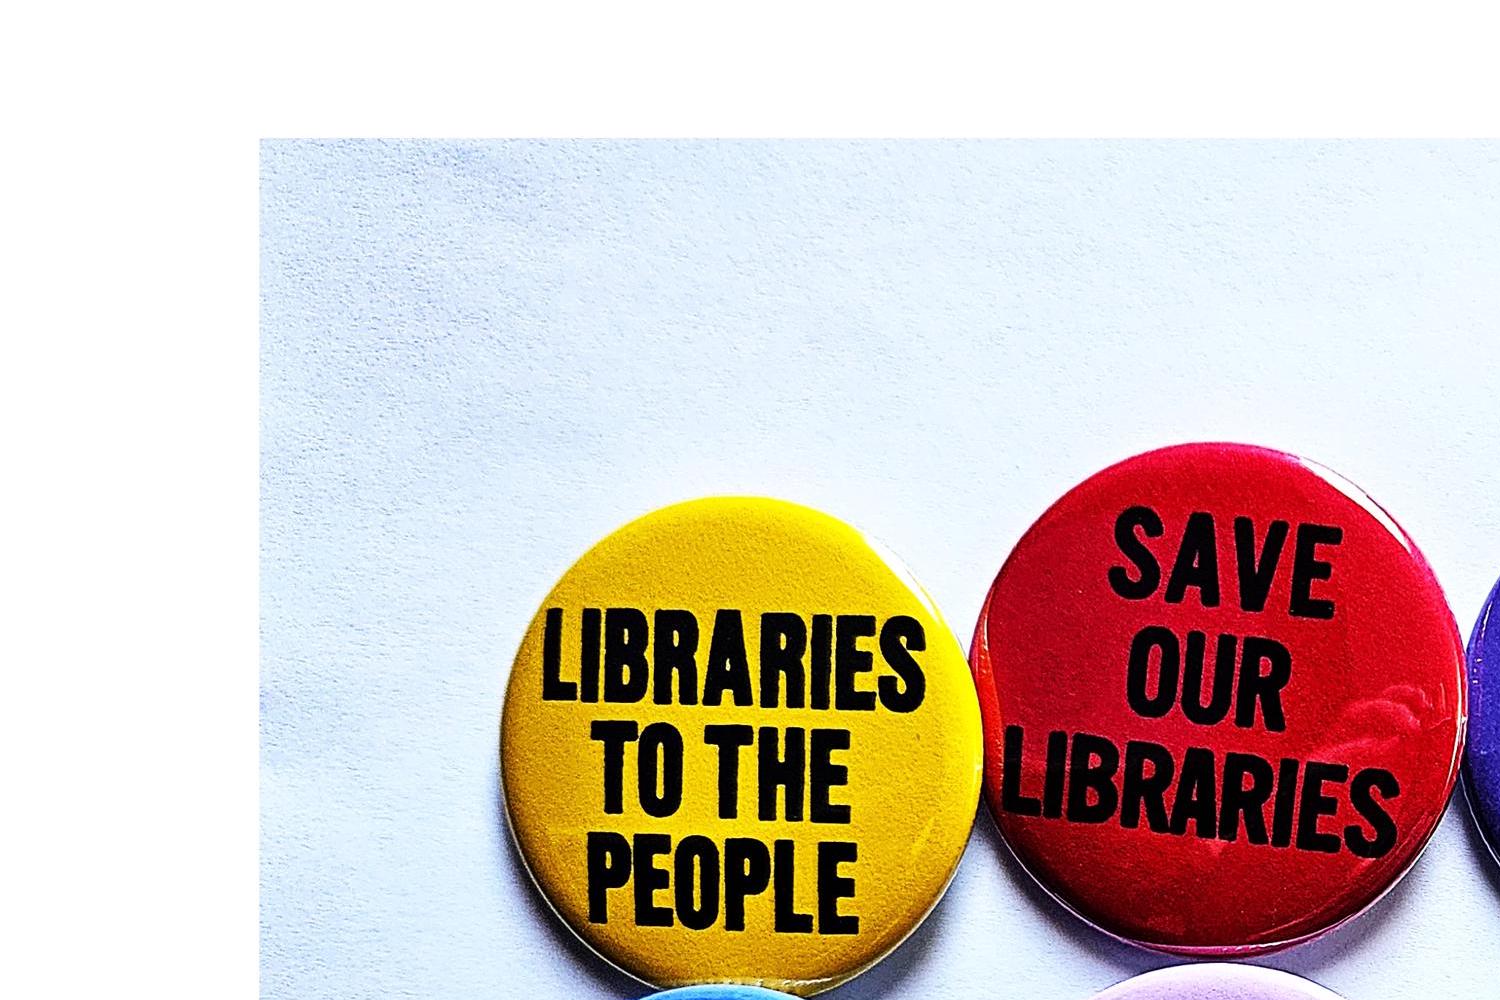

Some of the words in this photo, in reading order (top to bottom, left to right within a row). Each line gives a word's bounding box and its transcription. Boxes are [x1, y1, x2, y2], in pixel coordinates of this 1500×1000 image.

[1108, 505, 1343, 619] SAVE
[542, 607, 927, 714] LIBRARIES
[1126, 626, 1293, 732] OUR
[590, 720, 683, 817] TO
[704, 724, 852, 824] THE
[1002, 725, 1400, 859] LIBRARIES
[587, 831, 859, 935] PEOPLE
